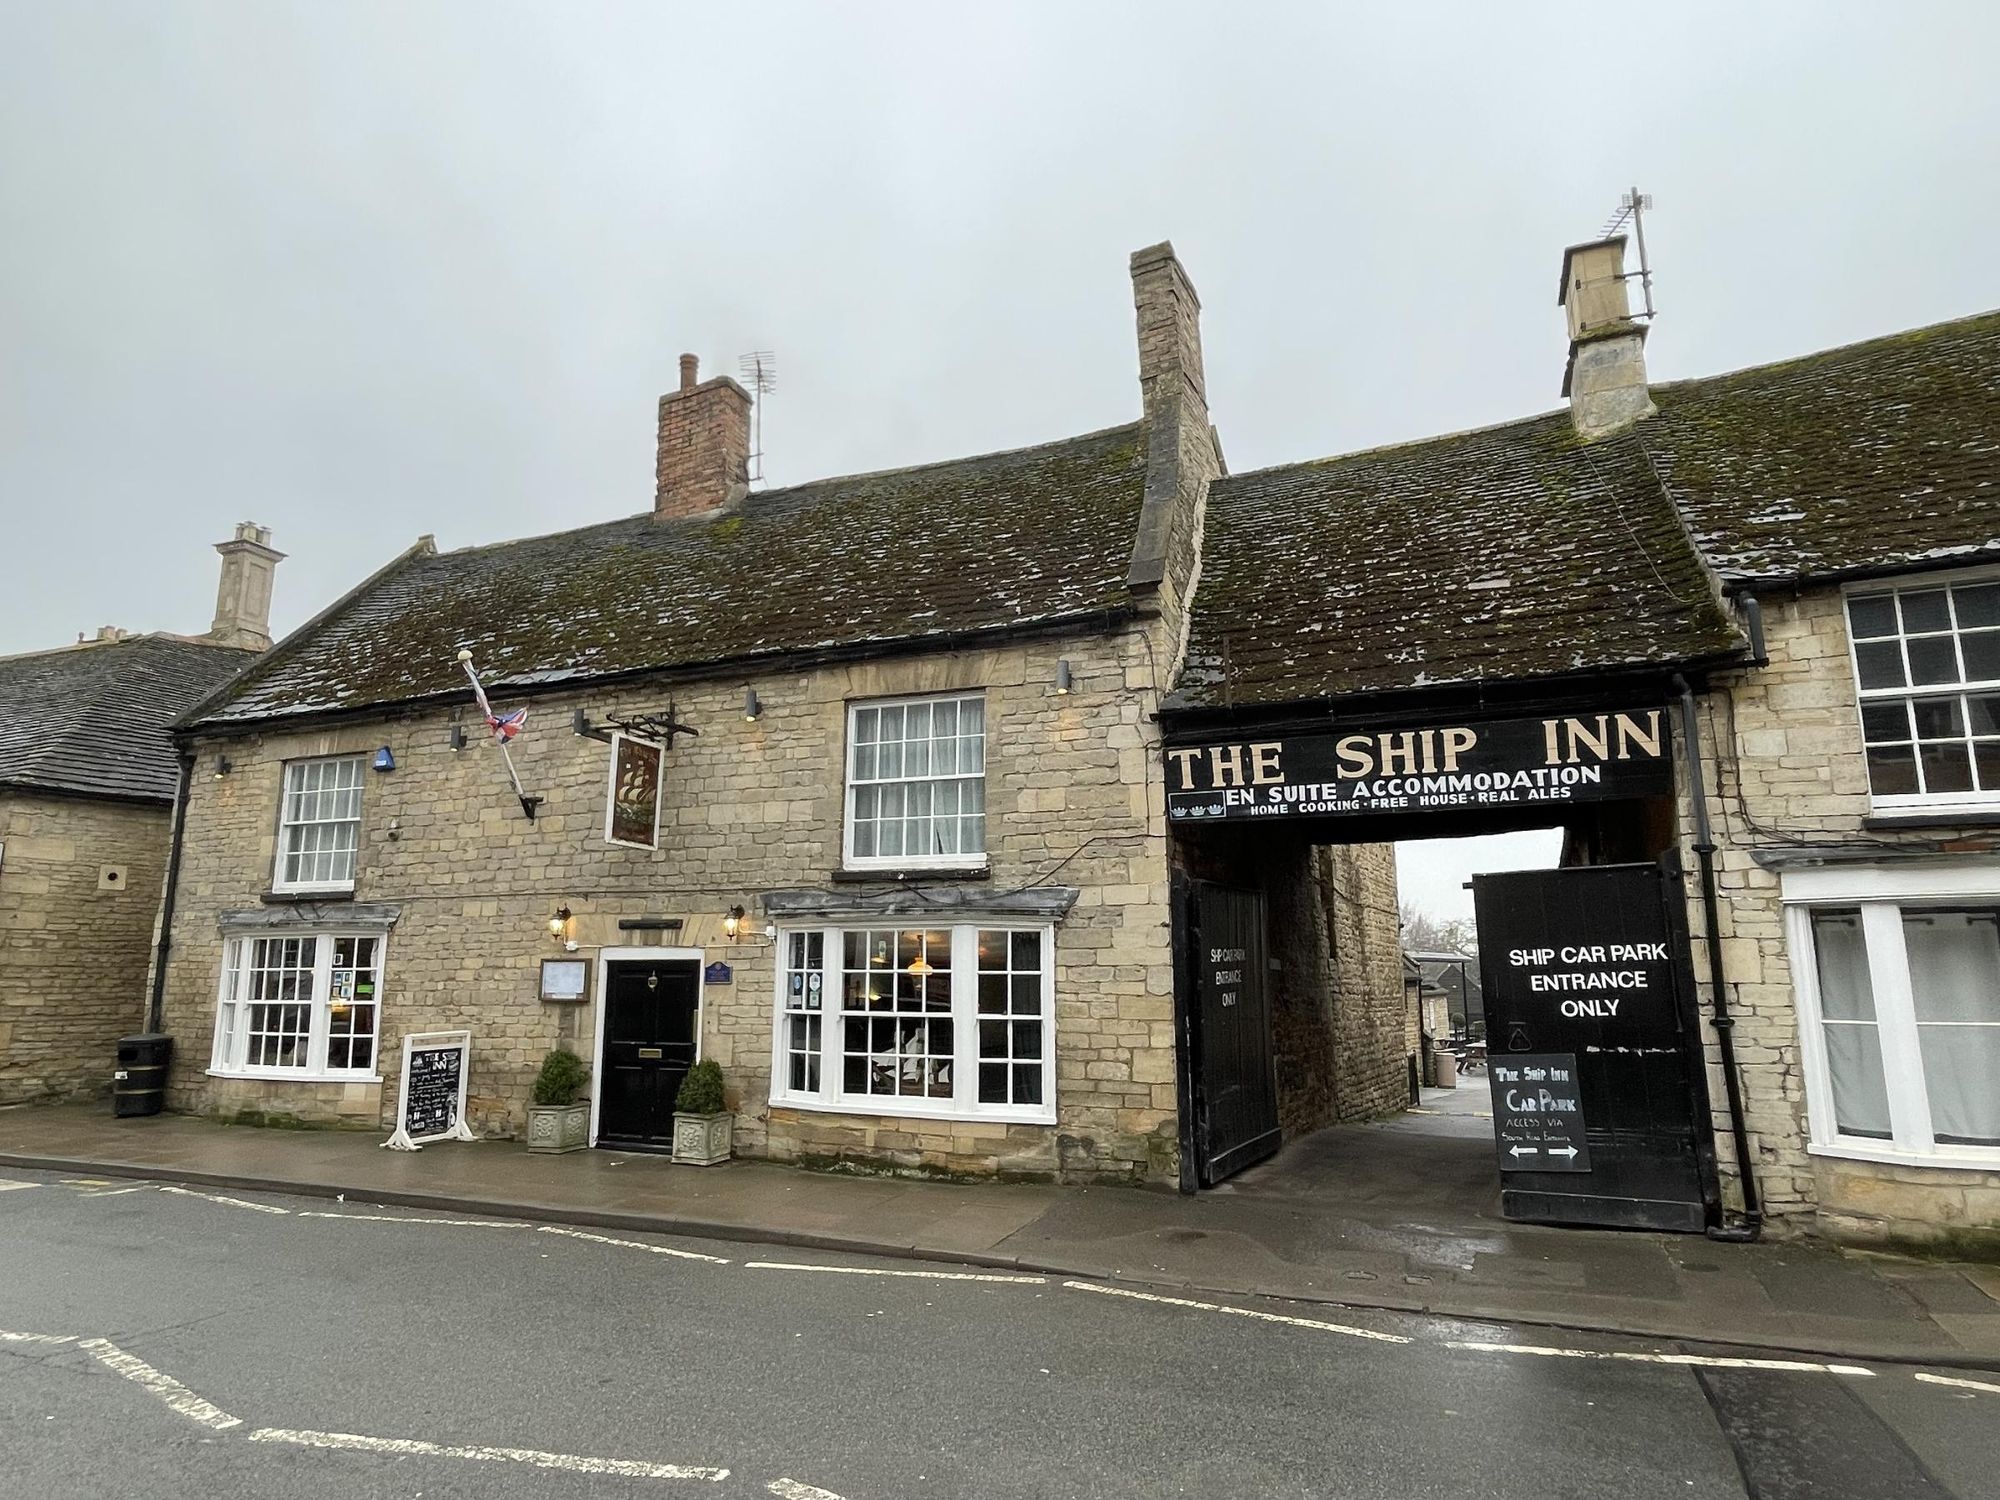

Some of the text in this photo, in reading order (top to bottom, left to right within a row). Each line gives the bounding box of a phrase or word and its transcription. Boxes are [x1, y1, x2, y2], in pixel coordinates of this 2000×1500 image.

[1168, 710, 1661, 789] THE SHIP INN
[1225, 765, 1601, 806] EN SUITE ACCOMMODATION
[1251, 786, 1571, 816] HOME COOKING FREE HOUSE REAL ALES
[1509, 942, 1668, 966] SHIP CAR PARK
[1530, 970, 1648, 992] ENTRANCE
[1560, 998, 1619, 1017] ONLY
